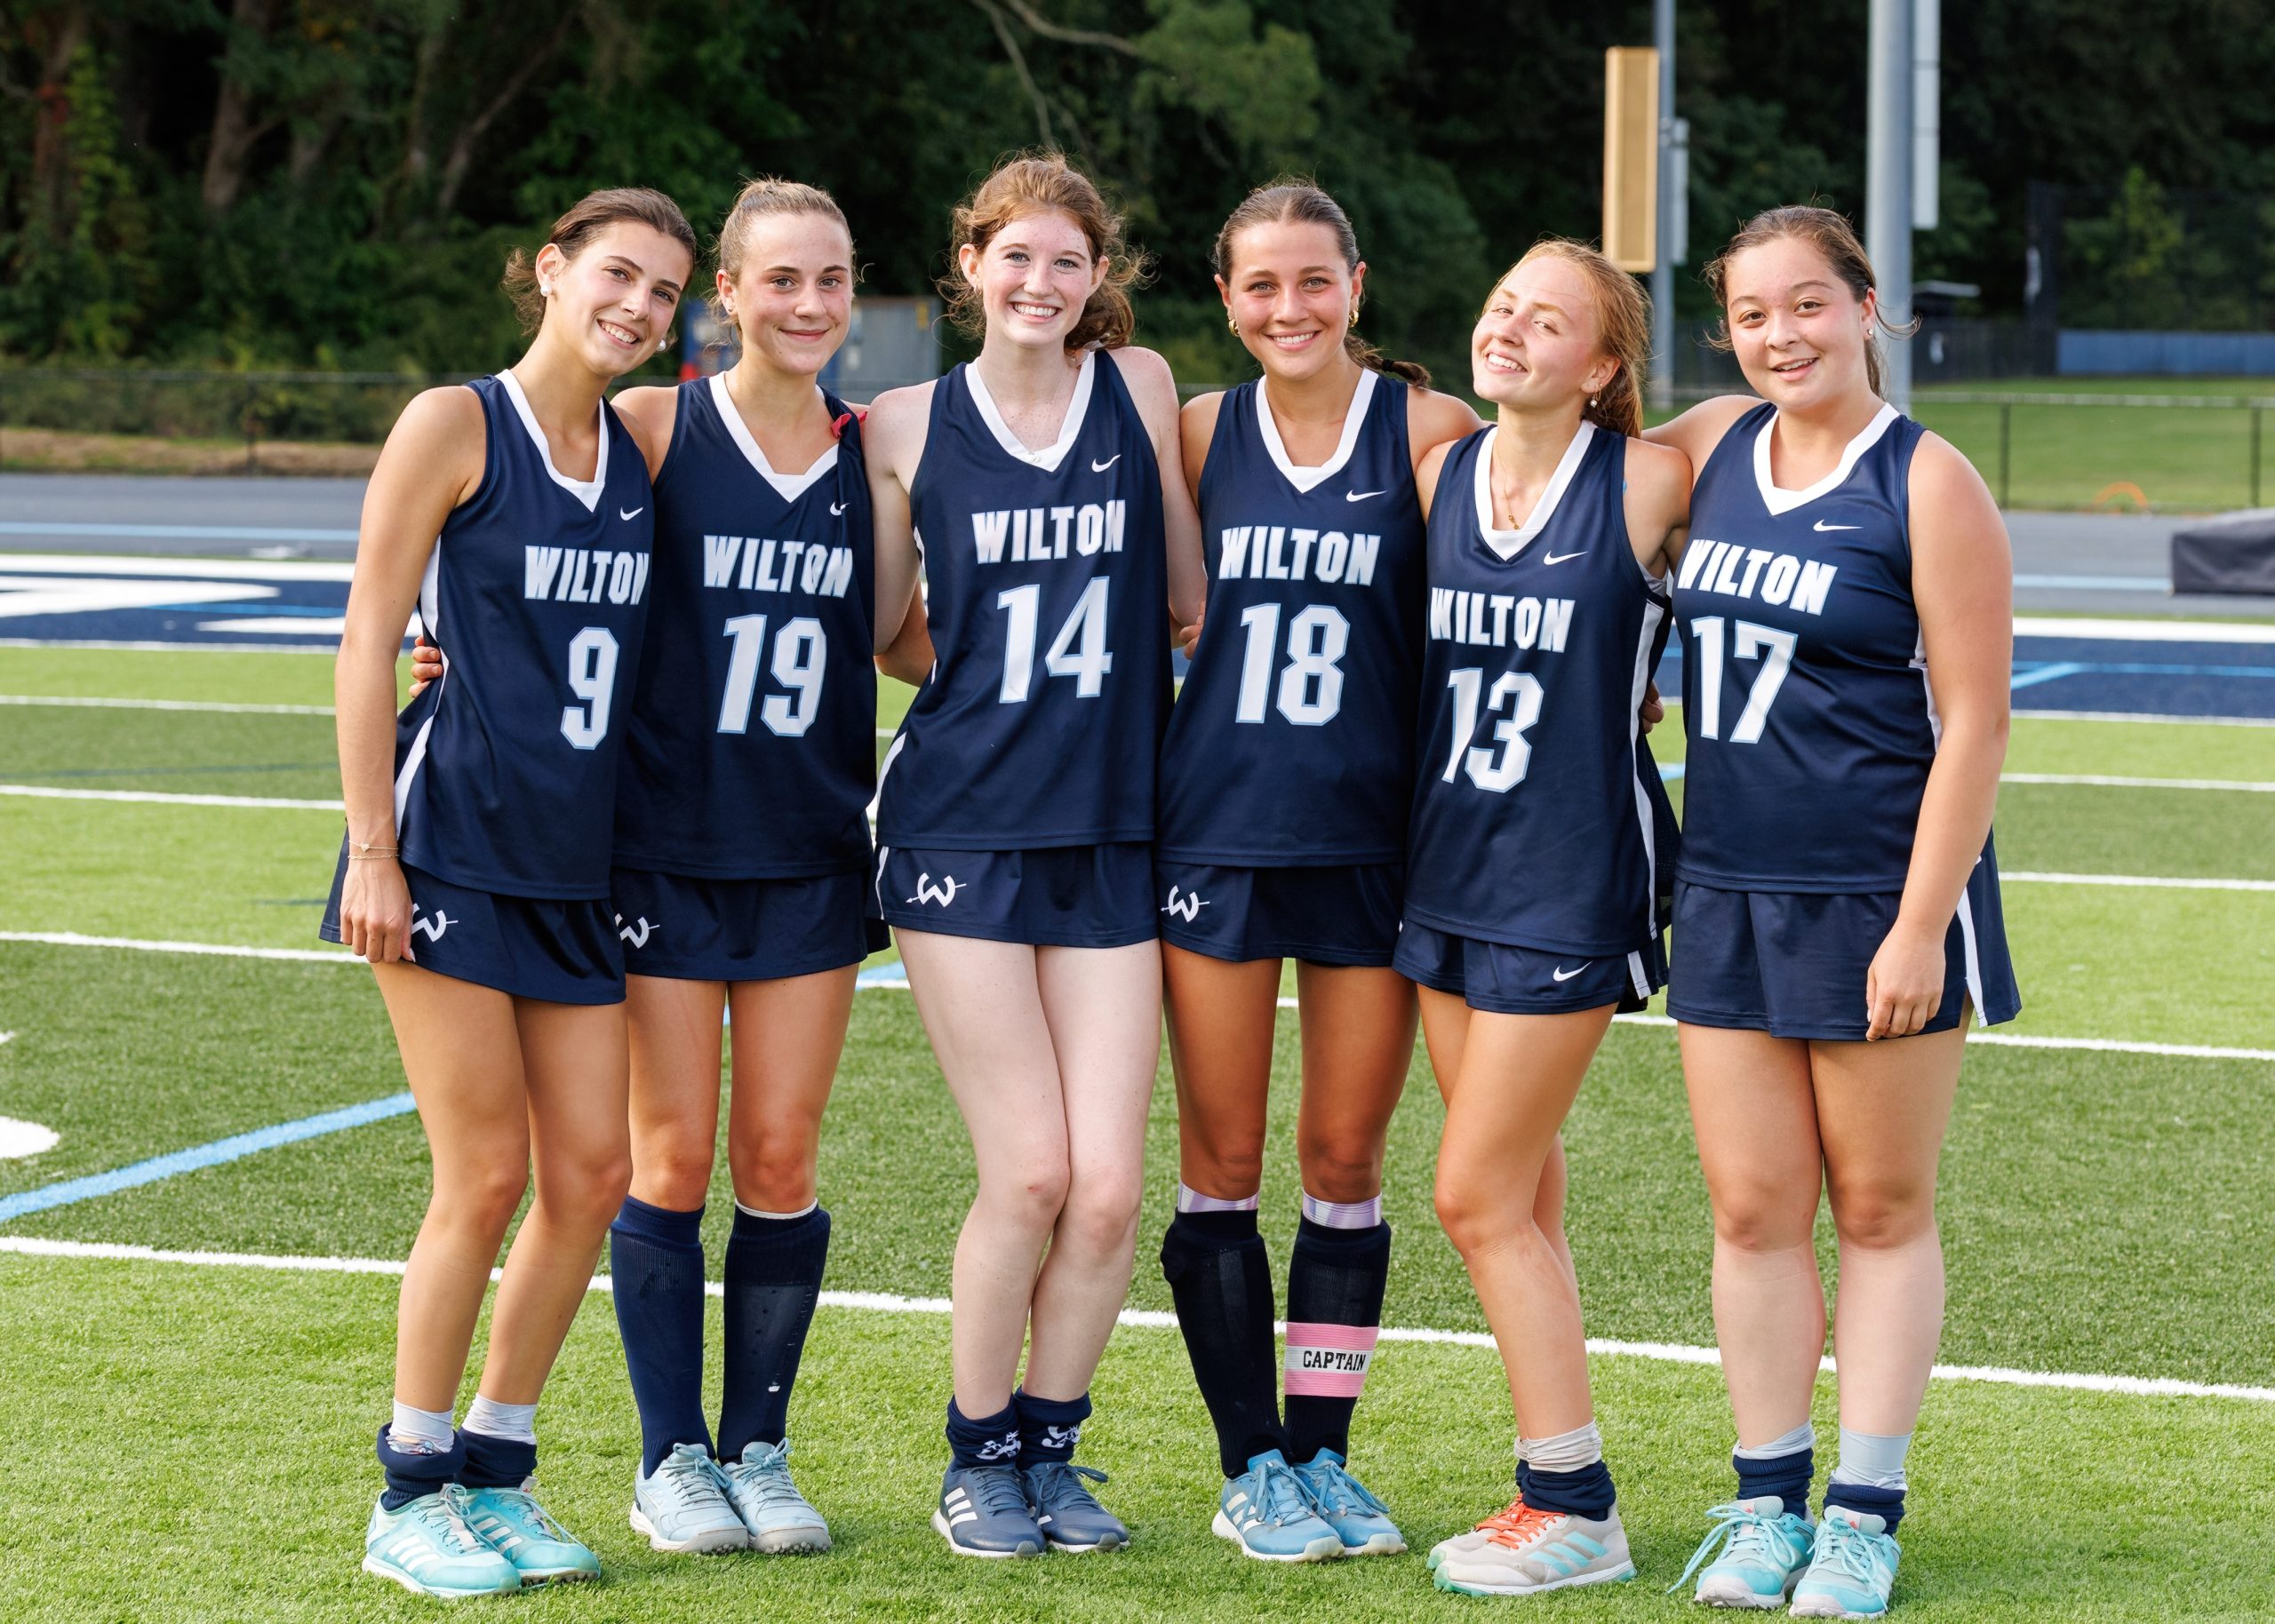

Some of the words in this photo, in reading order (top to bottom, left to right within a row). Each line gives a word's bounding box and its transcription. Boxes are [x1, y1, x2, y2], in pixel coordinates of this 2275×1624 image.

[703, 535, 853, 598] WILTON
[972, 499, 1126, 564] WILTON
[1218, 526, 1381, 585] WILTON
[524, 545, 650, 605] WILTON
[1677, 539, 1838, 616] WILTON
[997, 576, 1113, 704] 14
[1430, 586, 1576, 653] WILTON
[560, 626, 619, 750] 9
[716, 614, 826, 736] 19
[1235, 603, 1350, 726] 18
[1691, 616, 1798, 744] 17
[1441, 667, 1544, 793] 13
[1303, 1350, 1366, 1371] CAPTAIN
